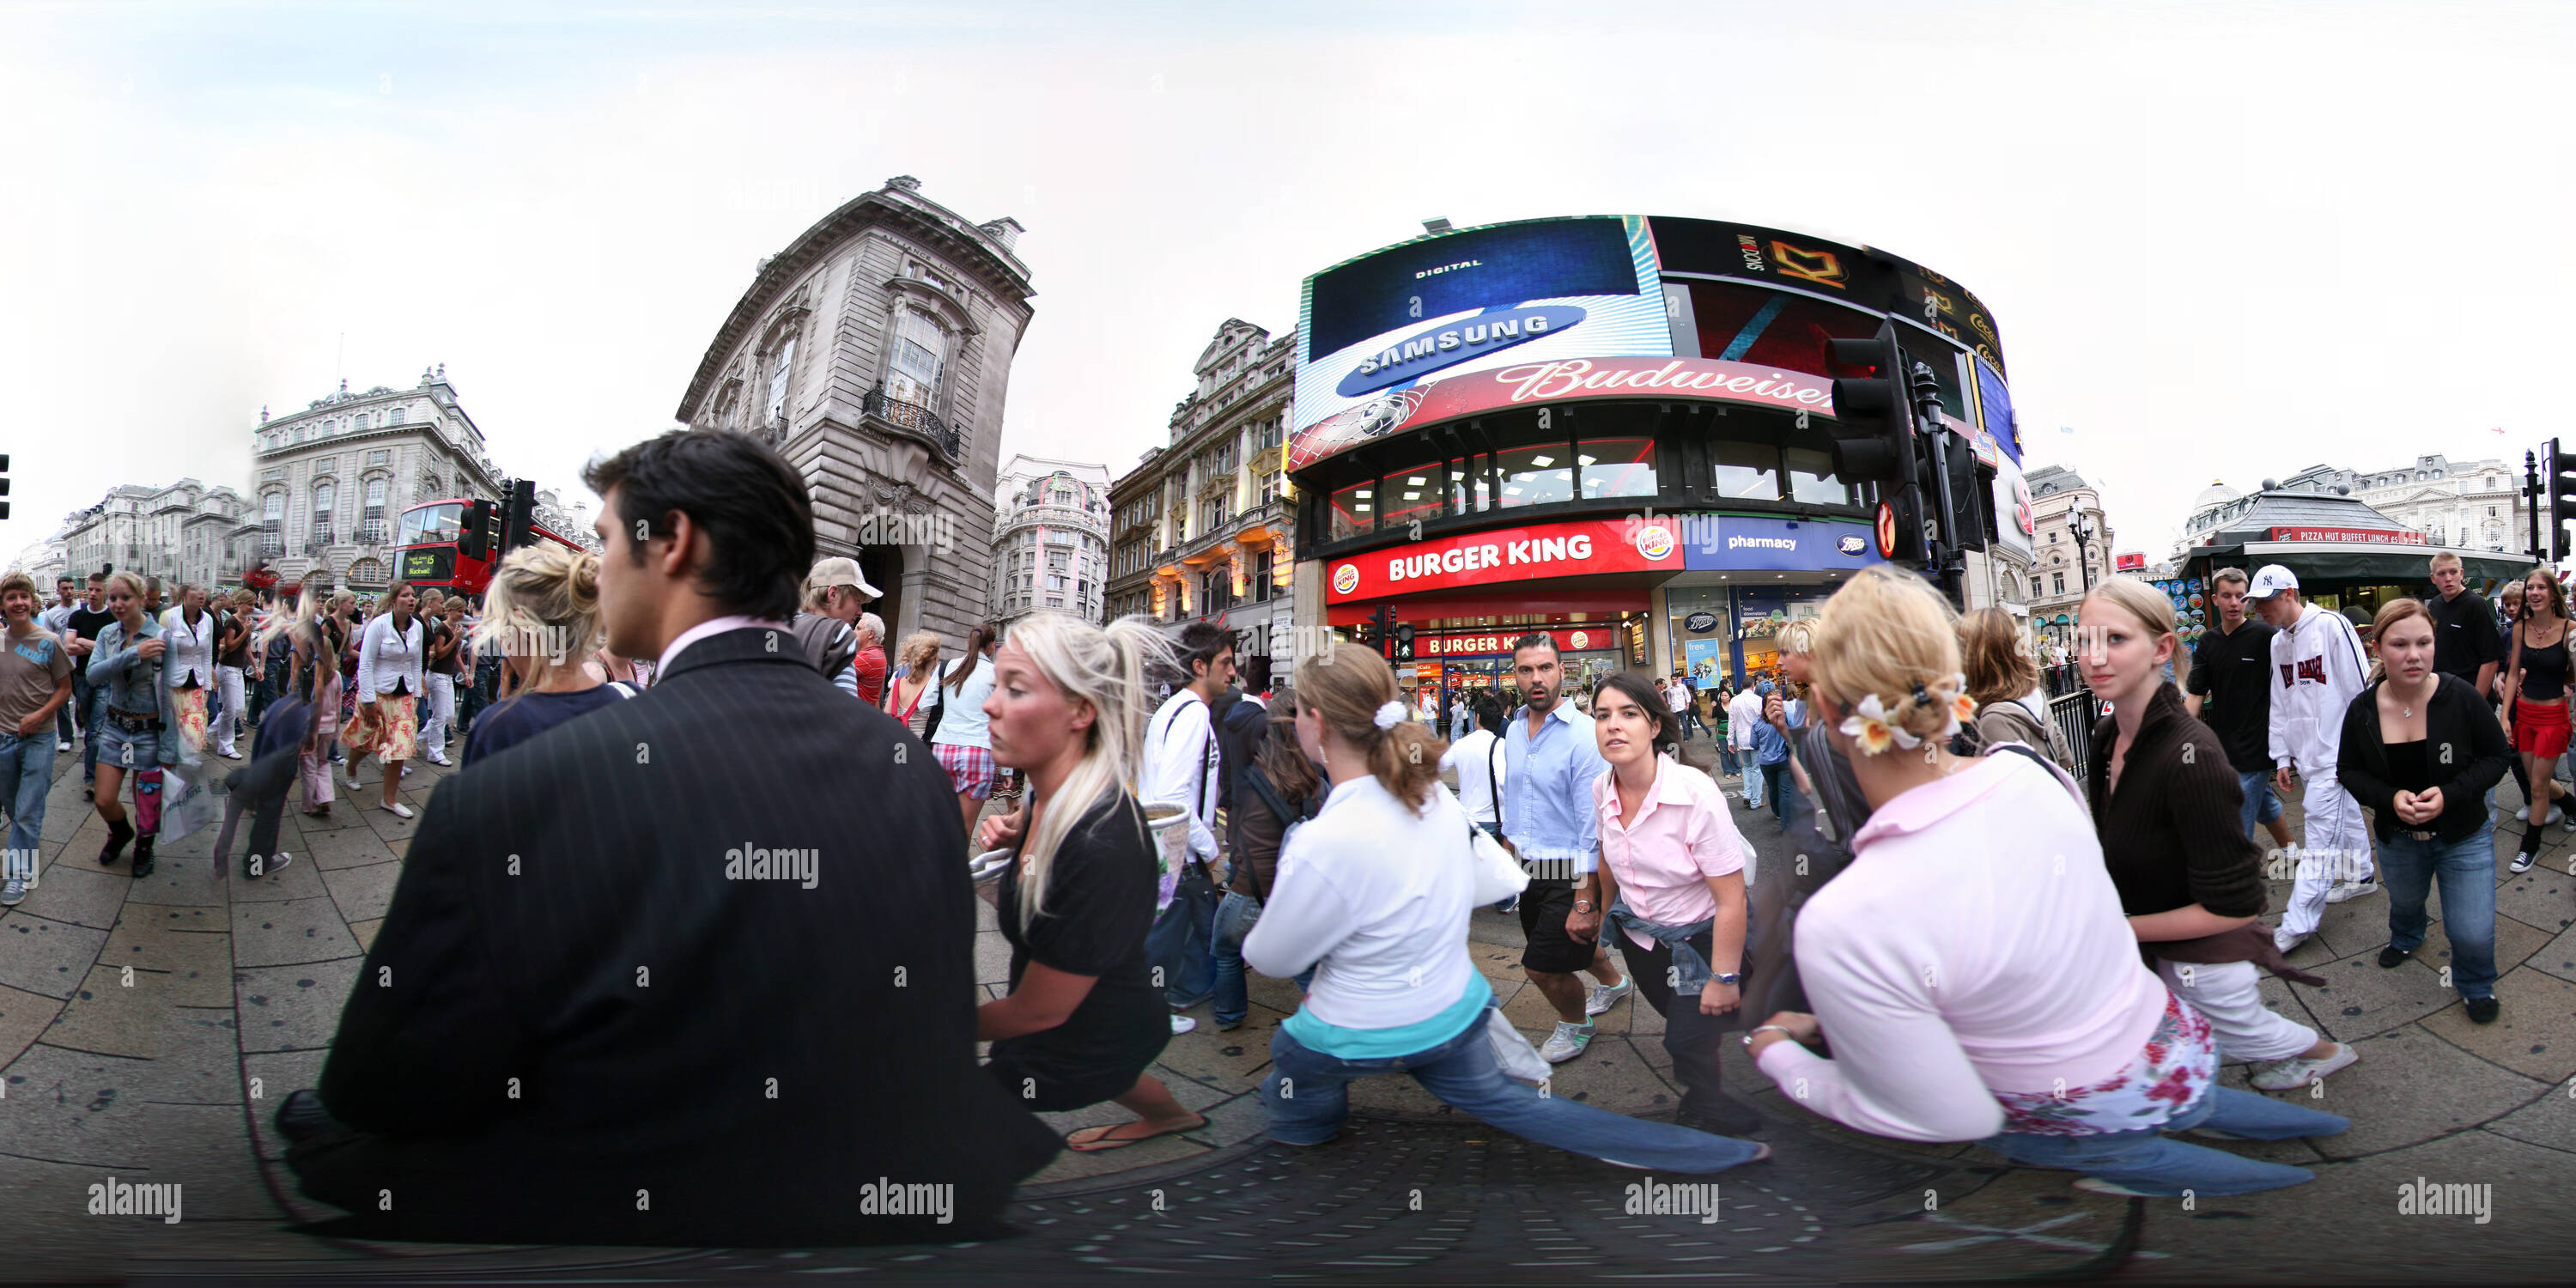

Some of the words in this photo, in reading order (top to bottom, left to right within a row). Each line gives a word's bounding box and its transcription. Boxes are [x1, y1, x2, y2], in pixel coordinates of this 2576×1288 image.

[883, 234, 932, 261] ALLIANCE
[939, 263, 957, 276] LIFE
[1414, 258, 1483, 280] DIGITAL
[1359, 315, 1548, 376] SAMSUNG
[1728, 534, 1796, 551] pharmacy
[1842, 536, 1866, 551] Boots
[2300, 532, 2323, 541] PIZZA
[2325, 532, 2339, 541] HUT
[2342, 533, 2366, 543] BUFFET
[2368, 534, 2389, 543] LUNCH
[1388, 544, 1500, 582] BURGER
[1508, 535, 1593, 563] KING
[1338, 574, 1355, 586] KING
[1688, 615, 1716, 630] Boots
[1430, 637, 1498, 653] BURGER
